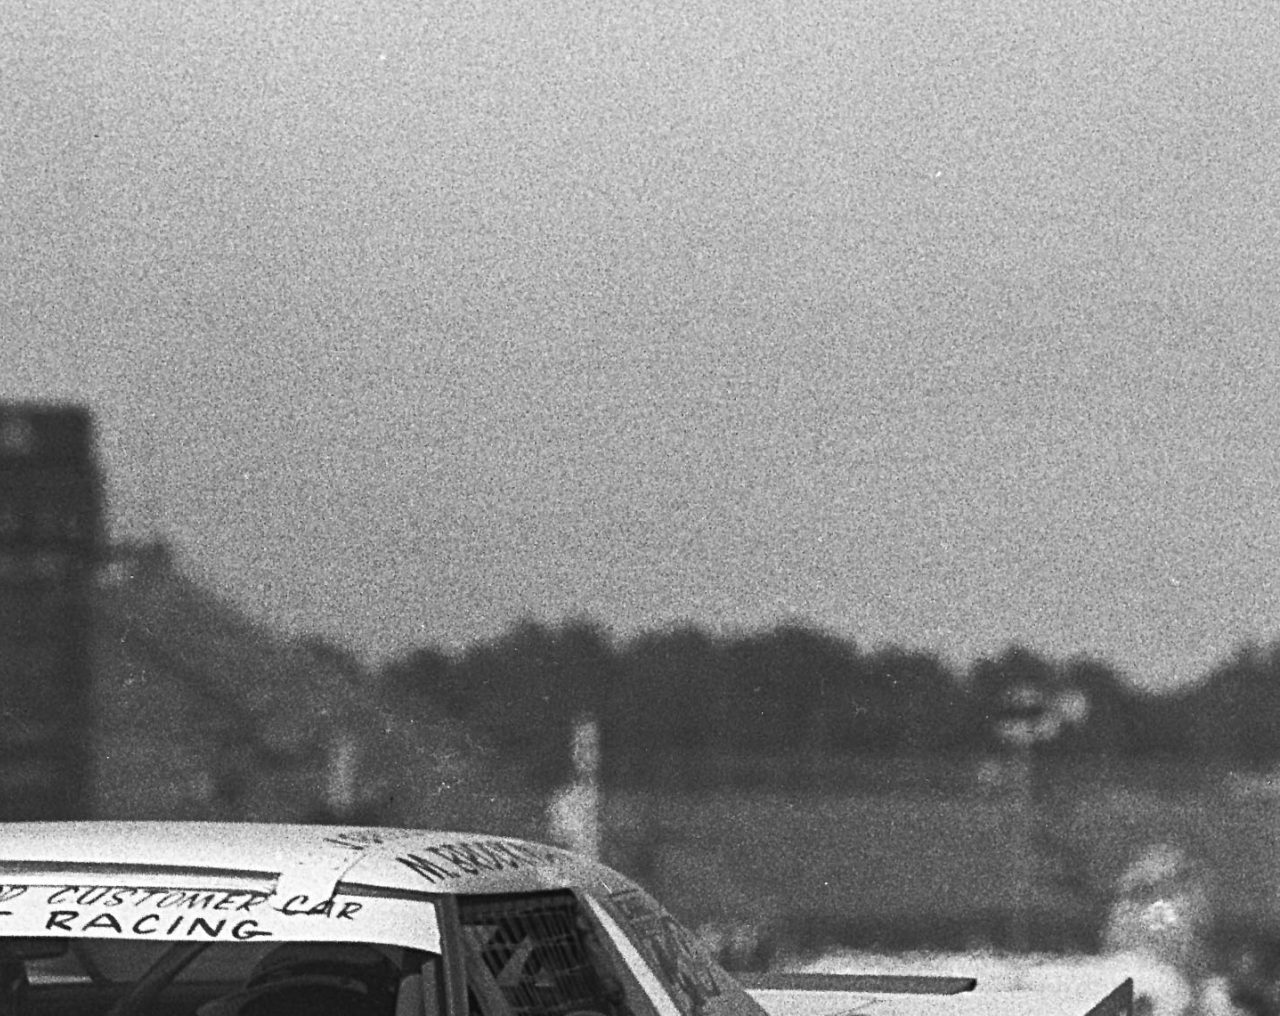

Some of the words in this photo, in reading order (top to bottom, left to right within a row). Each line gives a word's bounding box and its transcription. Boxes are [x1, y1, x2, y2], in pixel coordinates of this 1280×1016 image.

[46, 885, 272, 912] CUSTOMER
[274, 894, 364, 920] CAR
[44, 909, 274, 941] RACING
